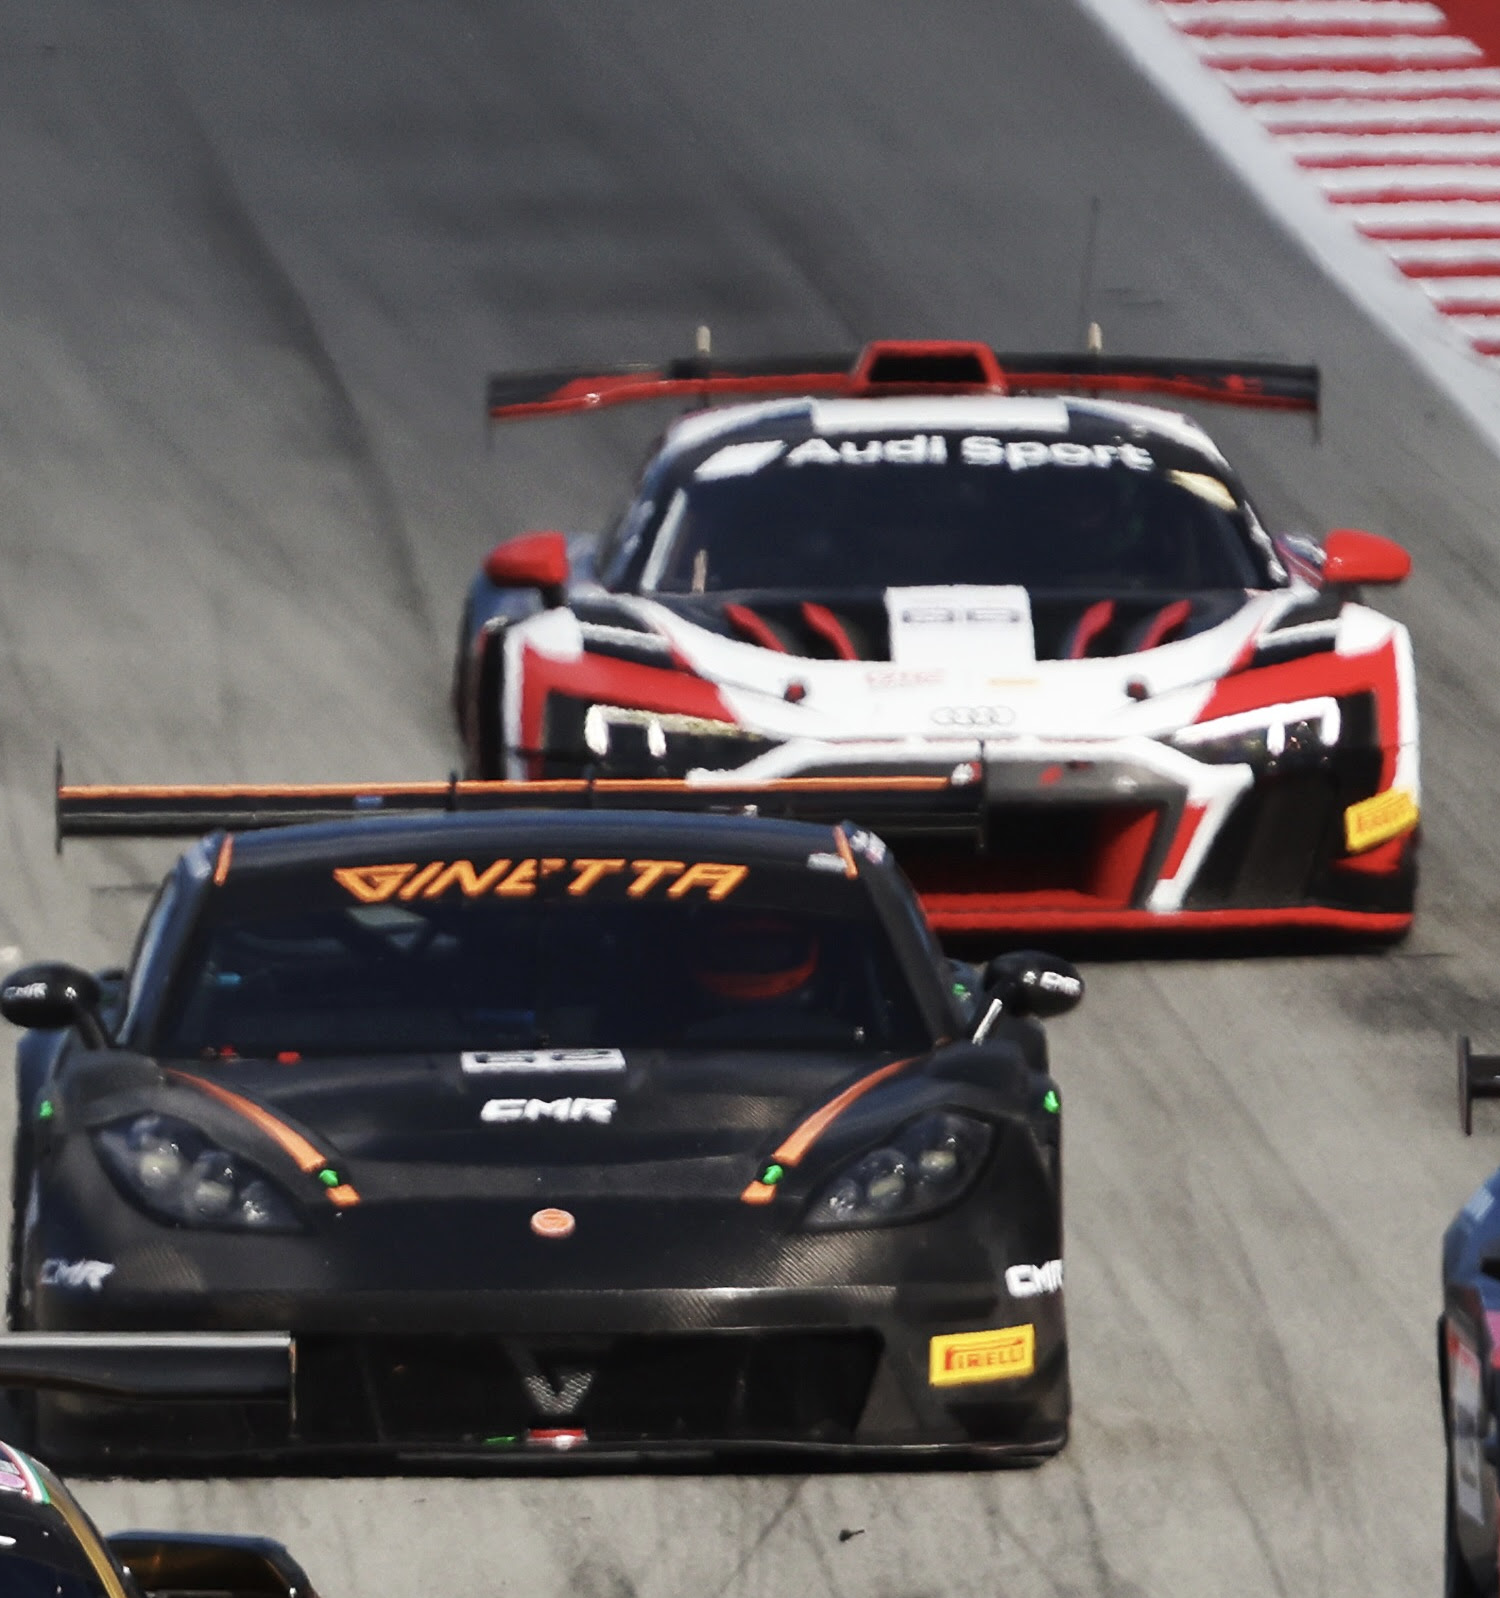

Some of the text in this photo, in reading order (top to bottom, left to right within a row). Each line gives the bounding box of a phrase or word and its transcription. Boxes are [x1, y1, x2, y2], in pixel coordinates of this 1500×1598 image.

[785, 434, 1156, 472] Audi Sport
[332, 858, 750, 902] GINETTA
[480, 1097, 618, 1124] CMR
[943, 1337, 1025, 1371] PIRELLI
